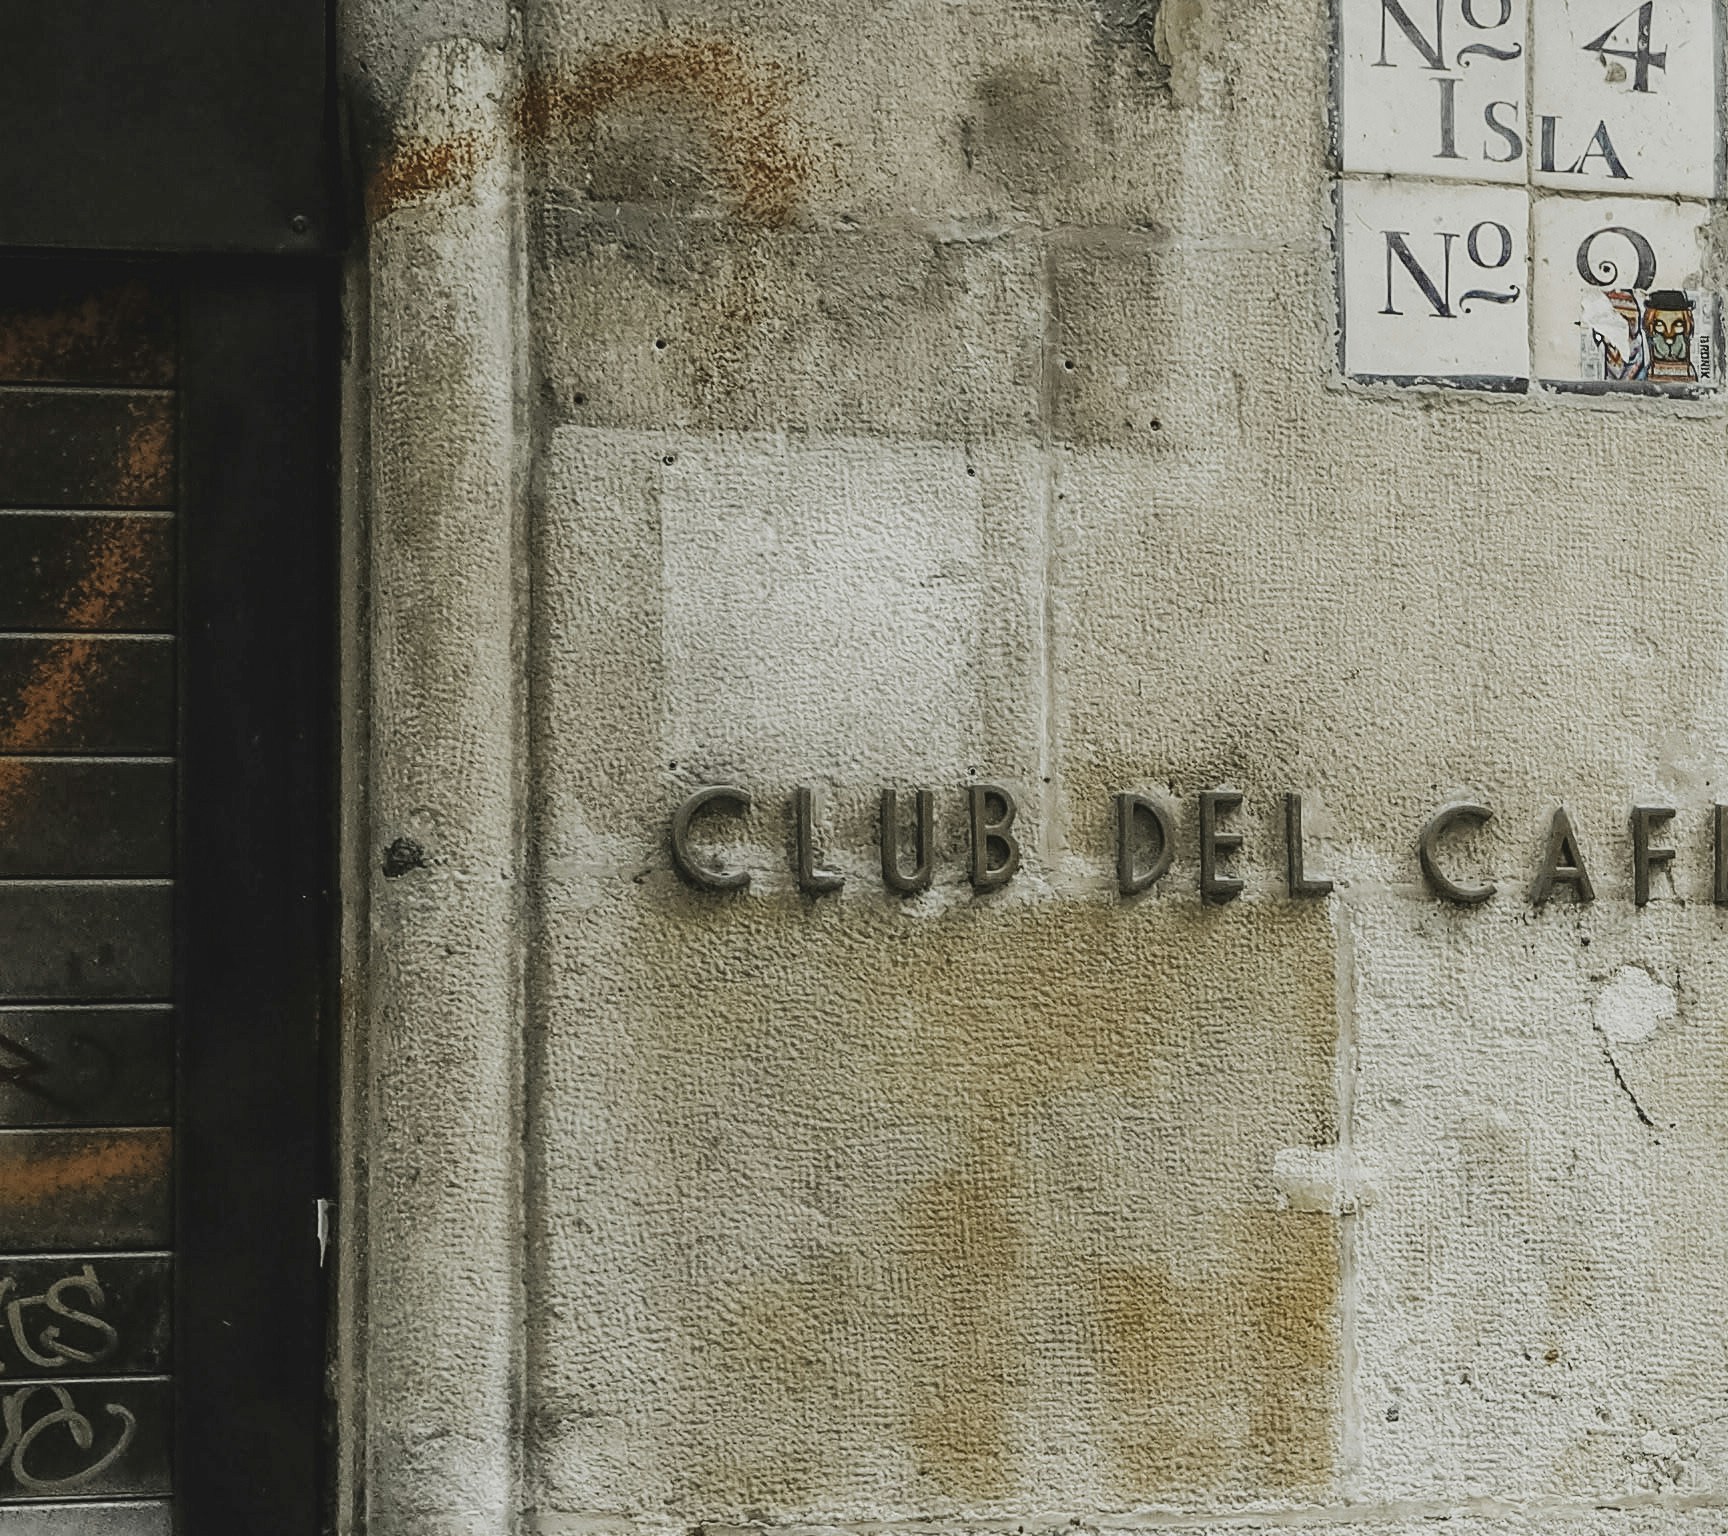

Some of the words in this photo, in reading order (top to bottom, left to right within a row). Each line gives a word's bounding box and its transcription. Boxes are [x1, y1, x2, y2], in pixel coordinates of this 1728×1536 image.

[1582, 1, 1667, 93] 4
[670, 784, 1021, 897] CLUB
[1116, 789, 1334, 900] DEL
